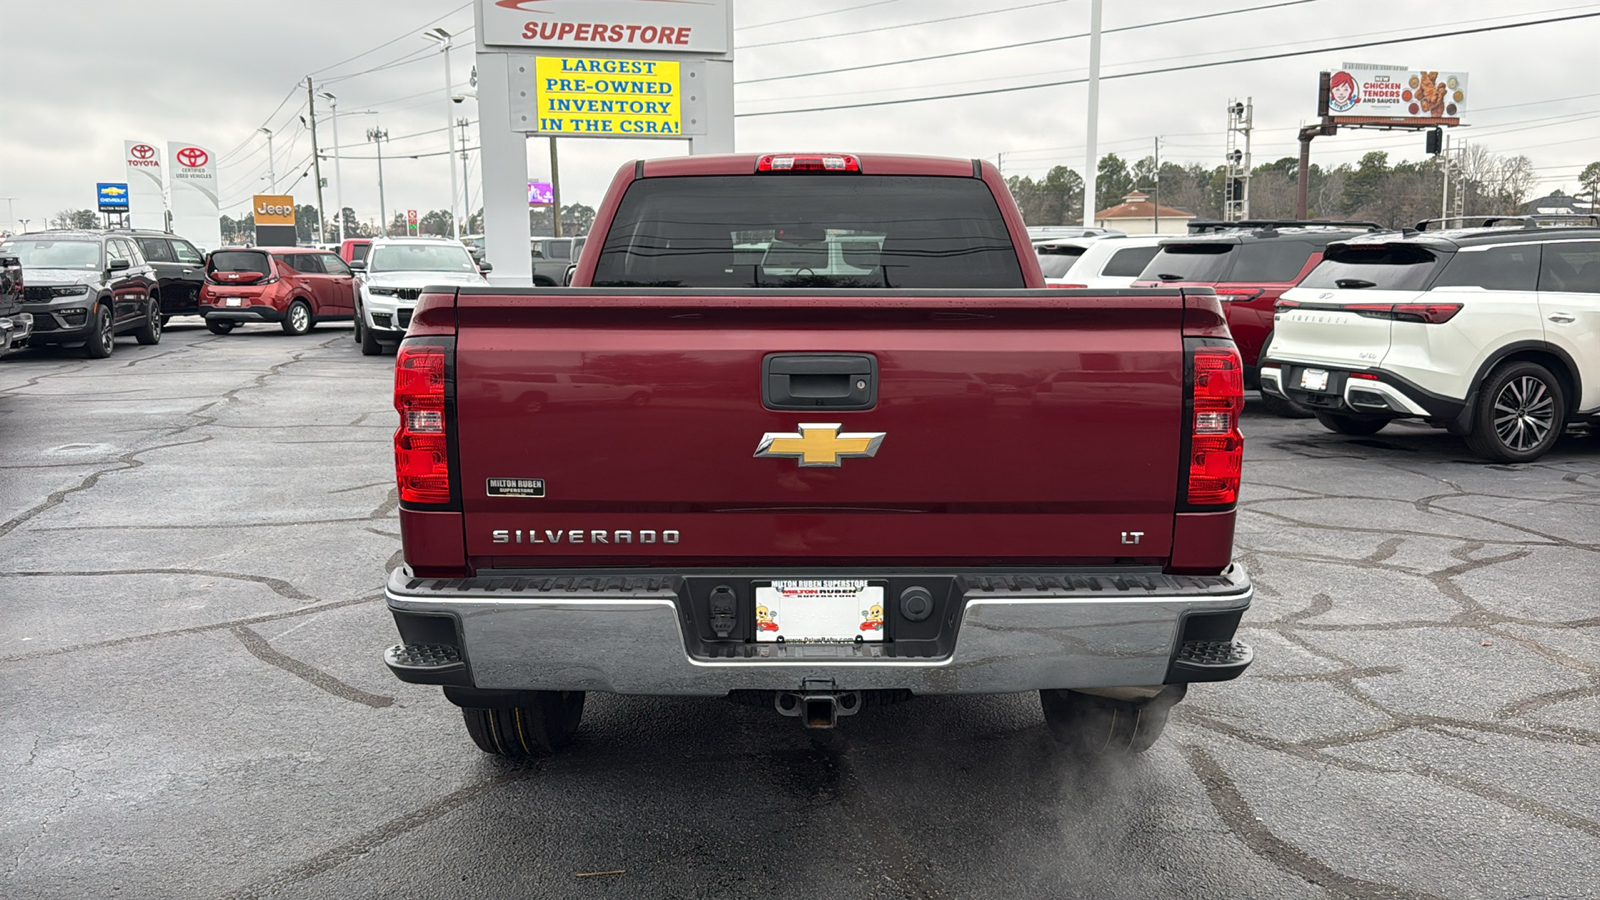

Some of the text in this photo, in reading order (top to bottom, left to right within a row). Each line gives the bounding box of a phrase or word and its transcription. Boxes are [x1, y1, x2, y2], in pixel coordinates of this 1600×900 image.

[522, 21, 692, 45] SUPERSTORE
[561, 59, 657, 74] LARGEST
[545, 78, 673, 94] PRE-OWNED
[1363, 82, 1401, 90] CHICKEN
[548, 98, 672, 114] INVENTORY
[540, 118, 680, 133] IN THE CSRA!
[127, 159, 160, 167] TOYOTA
[257, 202, 293, 218] Jeep
[1292, 314, 1348, 324] INFINITI
[490, 479, 542, 488] MILTON RUBEN
[492, 529, 680, 544] SILVERADO
[1121, 531, 1145, 545] LT
[771, 580, 869, 588] MILTON RUBEN SUPERSTORE
